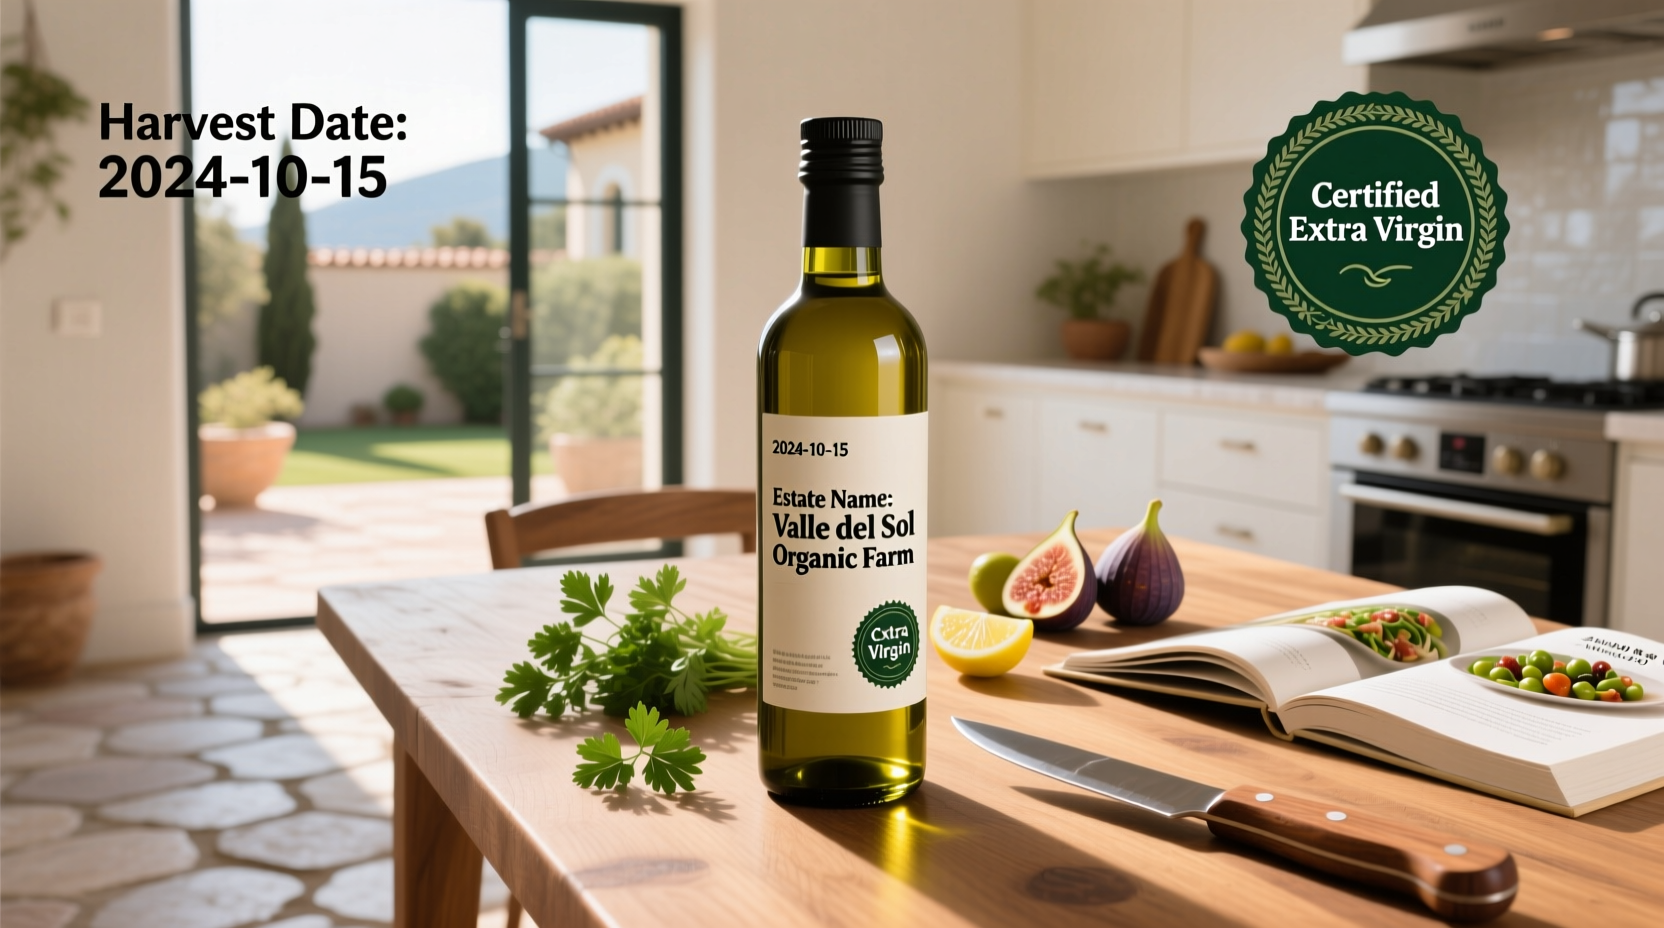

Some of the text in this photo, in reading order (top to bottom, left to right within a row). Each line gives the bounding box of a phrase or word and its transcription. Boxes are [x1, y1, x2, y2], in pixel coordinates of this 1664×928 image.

[772, 439, 849, 457] 2024-10-15
[773, 487, 893, 509] Estate Name:
[772, 509, 915, 540] Valle del Sol
[772, 543, 914, 576] Organic Farm
